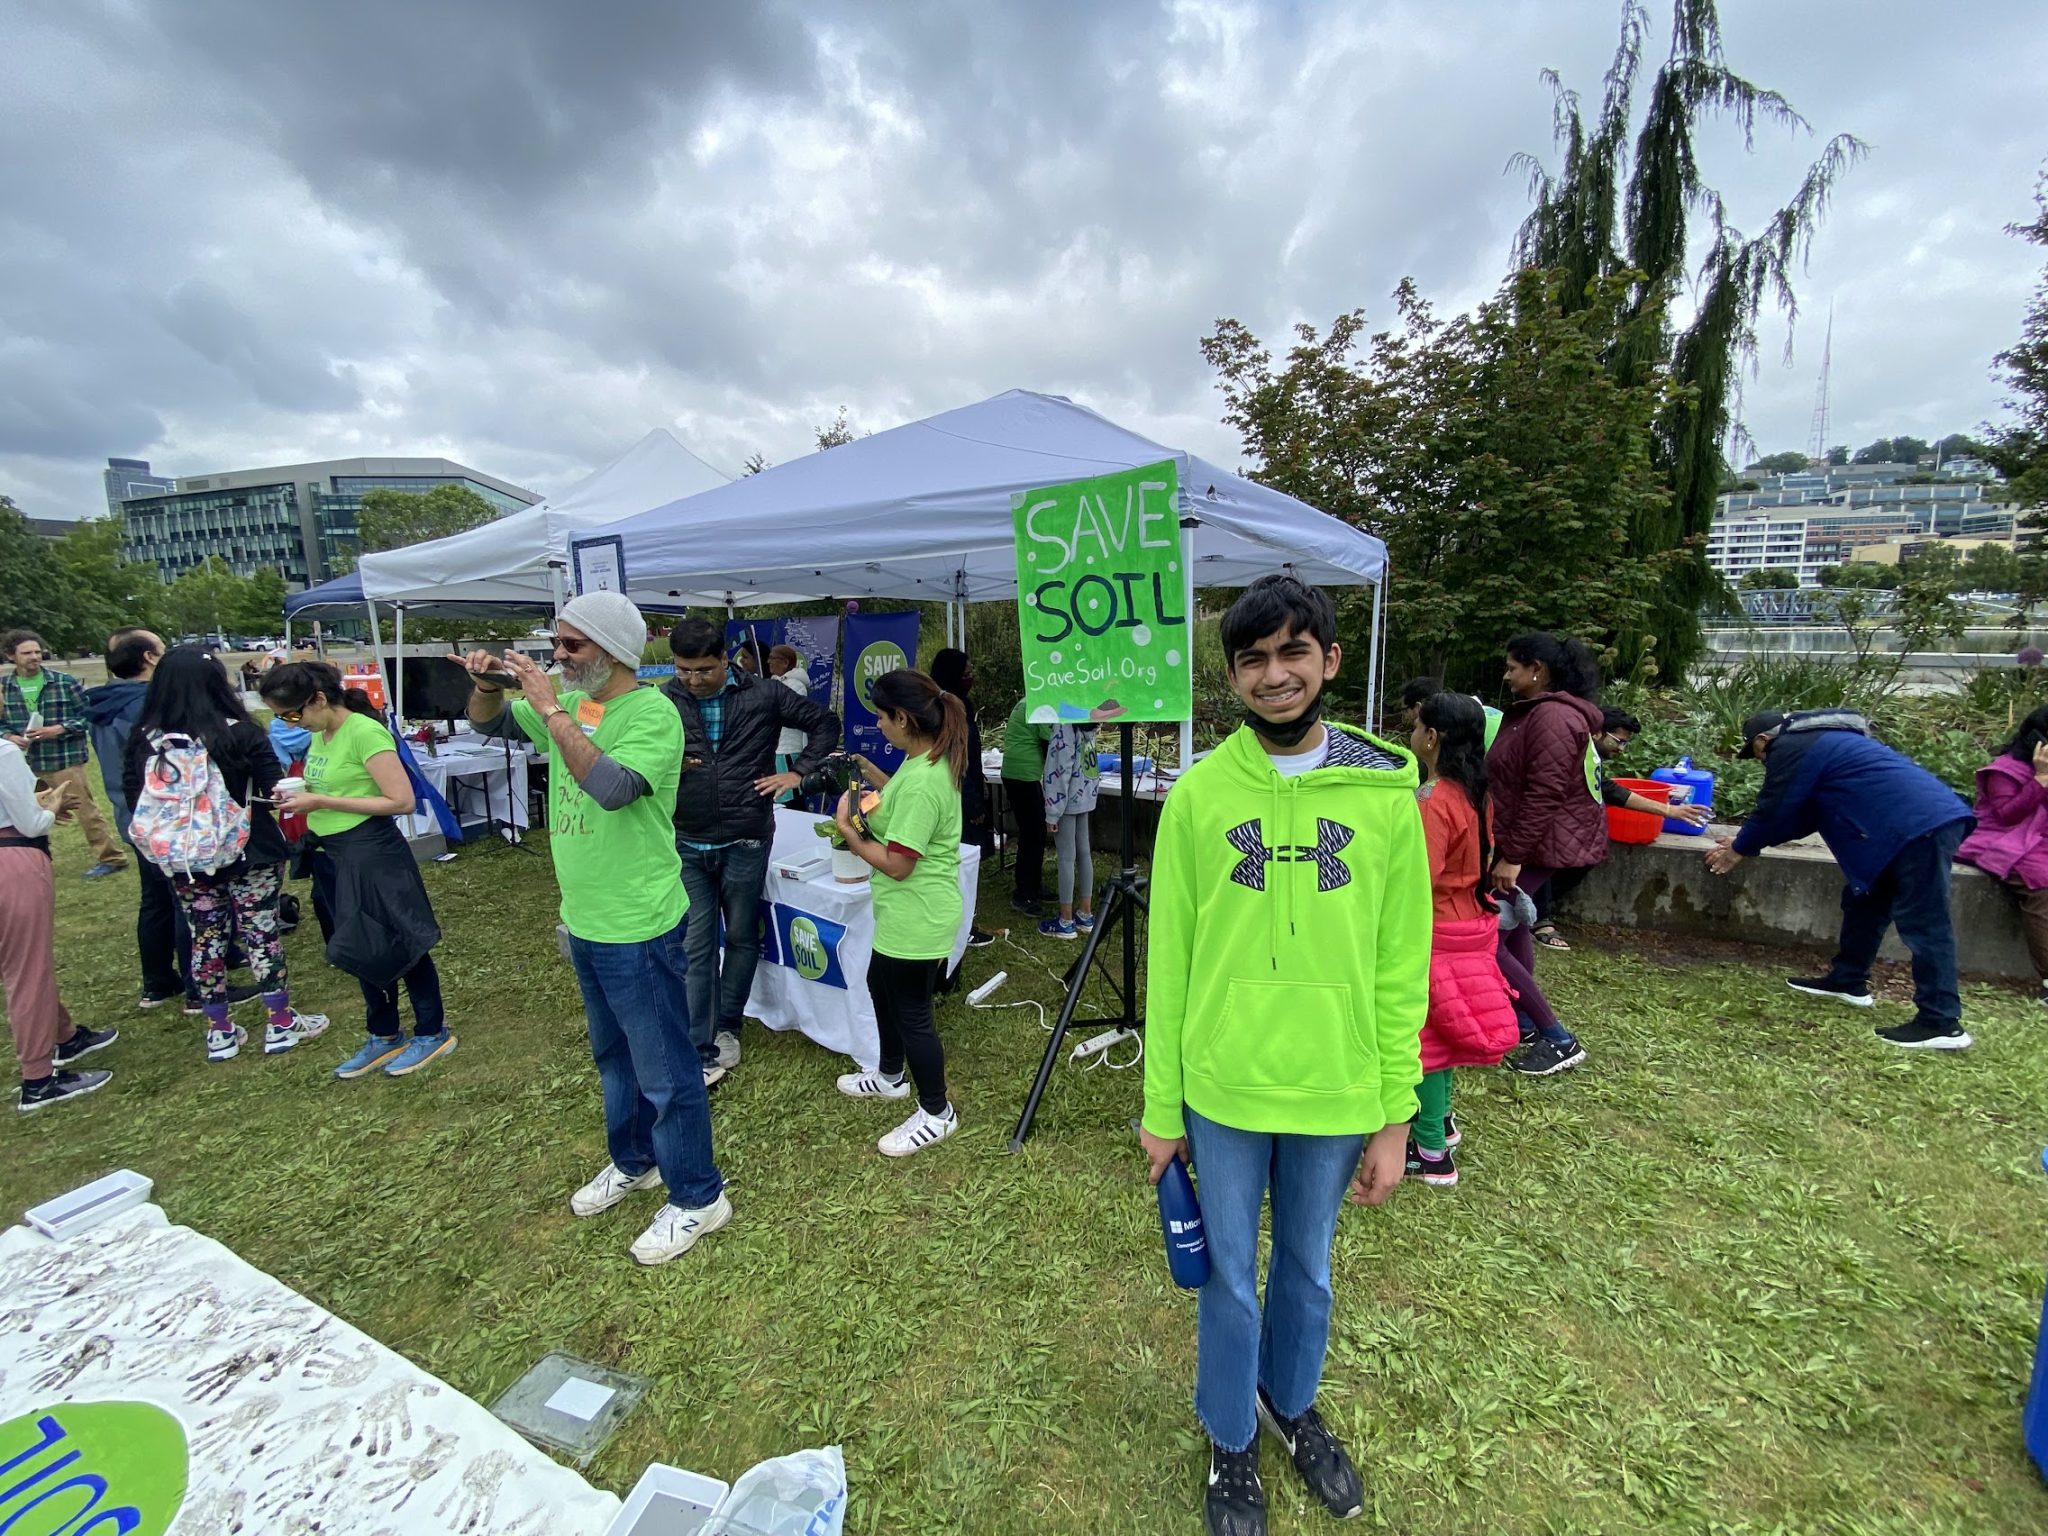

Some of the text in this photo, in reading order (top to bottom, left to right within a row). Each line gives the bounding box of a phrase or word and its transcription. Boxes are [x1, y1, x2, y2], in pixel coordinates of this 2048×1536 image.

[1026, 481, 1171, 574] SAVE
[1034, 571, 1186, 643] SOIL
[863, 654, 901, 676] SAVE
[794, 926, 818, 952] SAVE
[795, 944, 821, 971] SOIL
